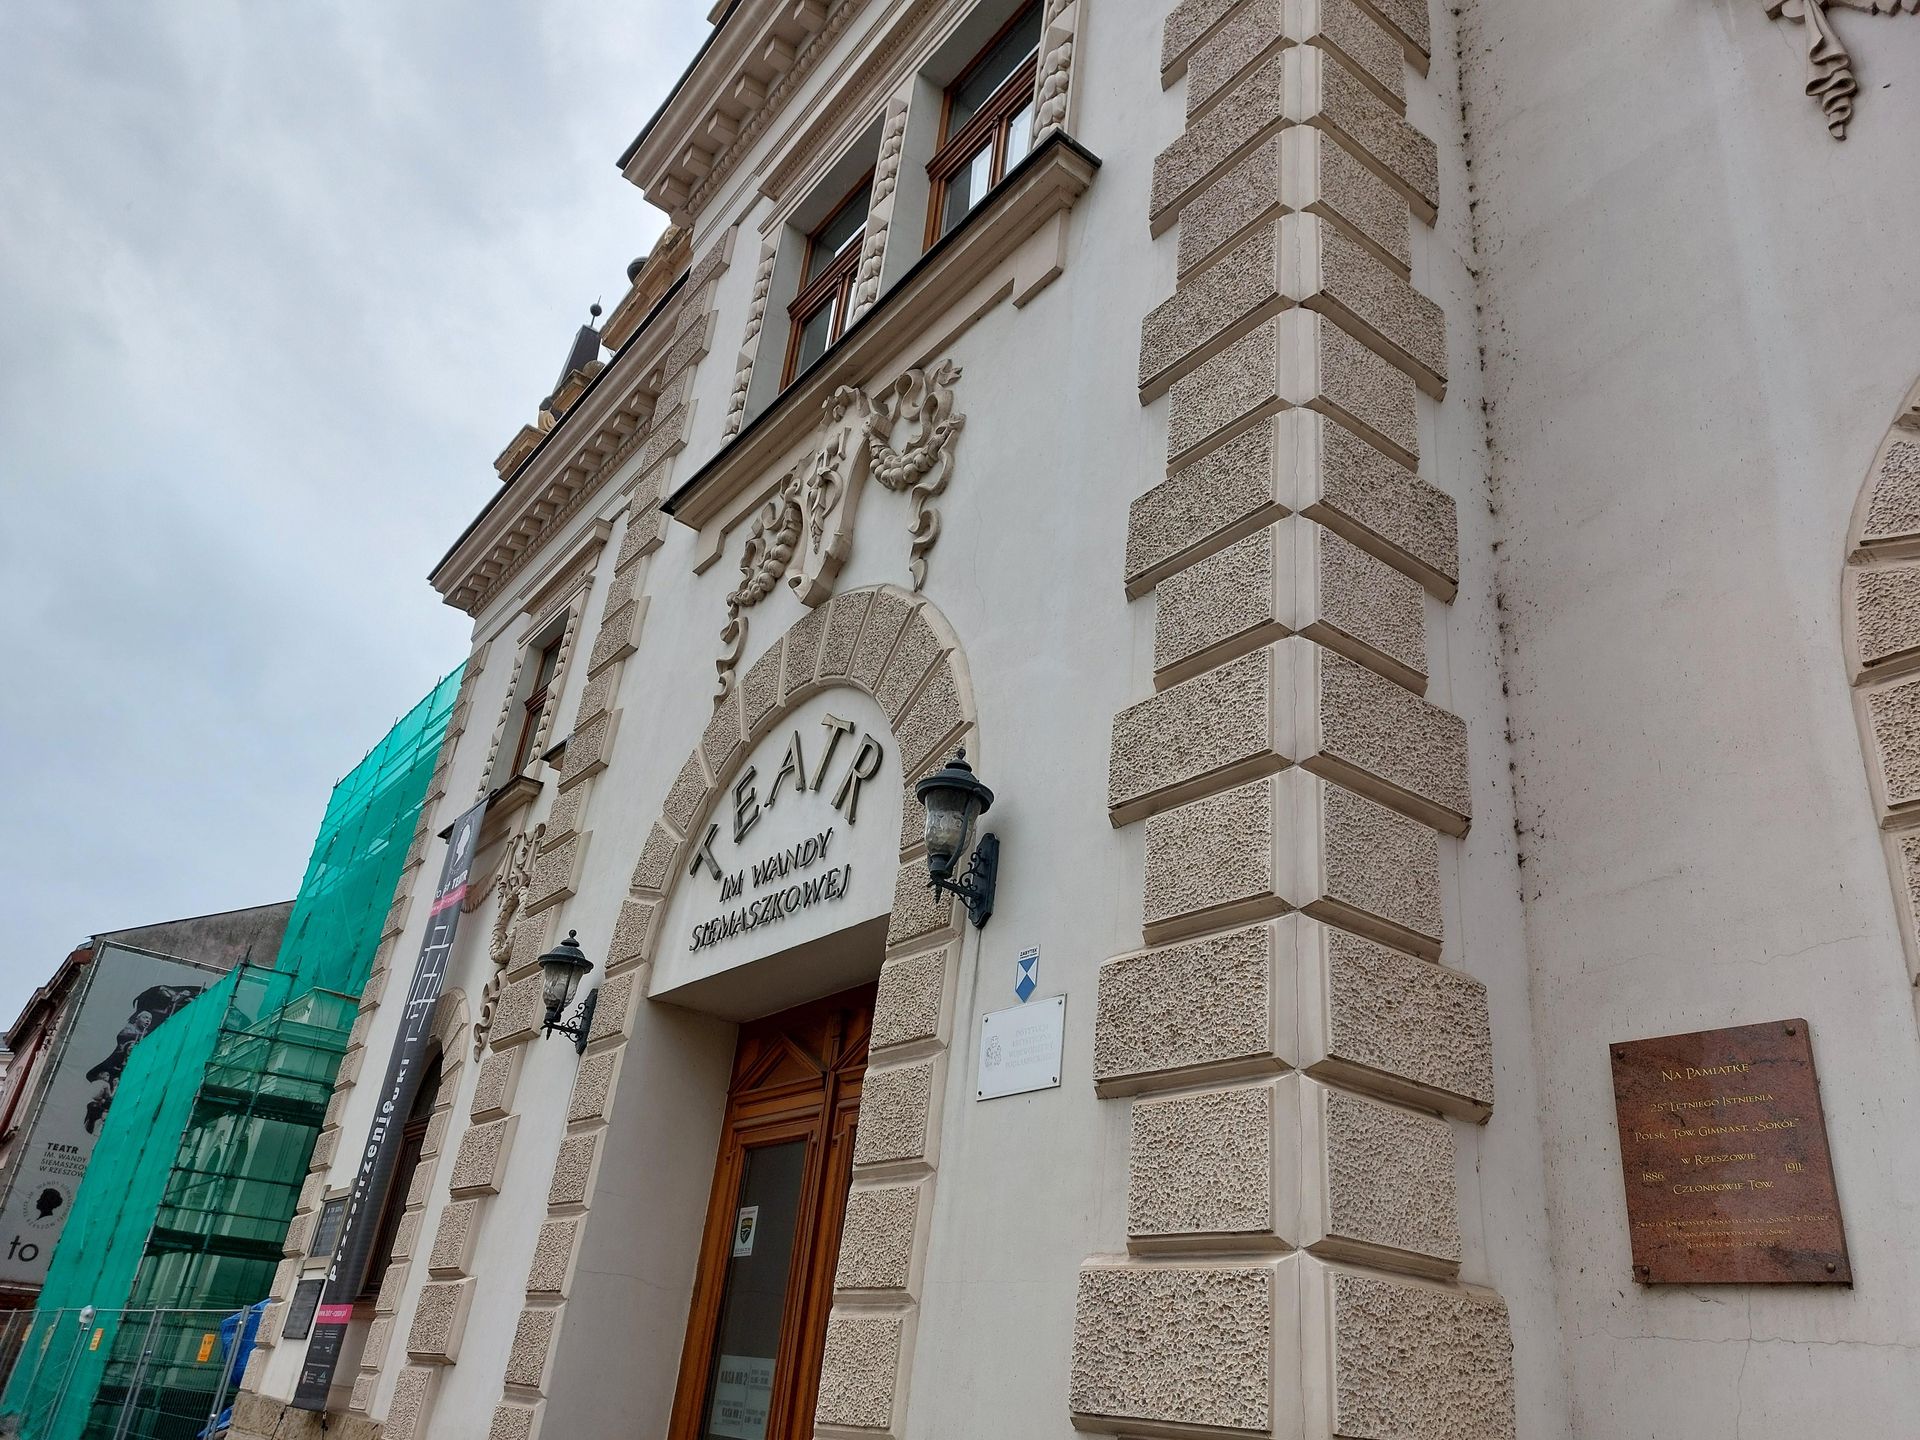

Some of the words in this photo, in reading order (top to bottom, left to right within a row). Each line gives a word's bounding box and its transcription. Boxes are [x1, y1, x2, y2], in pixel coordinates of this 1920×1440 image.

[688, 712, 884, 881] TEATR
[719, 869, 744, 903] IM
[751, 827, 833, 889] WANDY
[688, 863, 852, 952] SIEMASZKOWEJ
[44, 1151, 56, 1159] IM.
[58, 1153, 87, 1163] WANDY
[47, 1142, 79, 1155] TEATR
[7, 1235, 39, 1262] to
